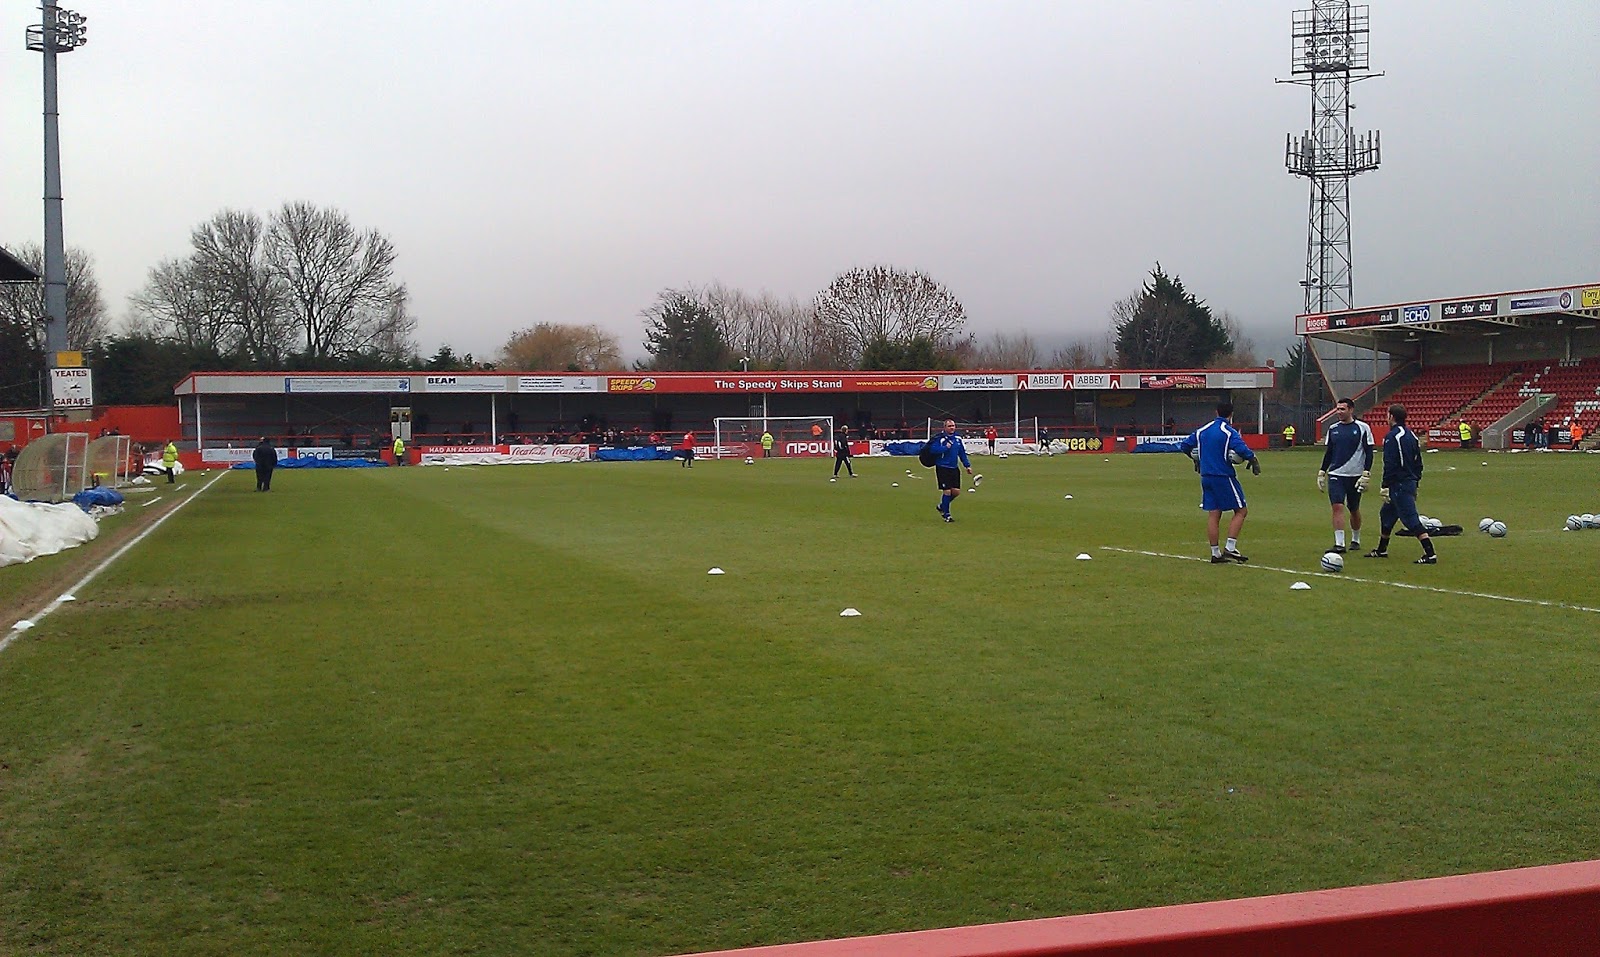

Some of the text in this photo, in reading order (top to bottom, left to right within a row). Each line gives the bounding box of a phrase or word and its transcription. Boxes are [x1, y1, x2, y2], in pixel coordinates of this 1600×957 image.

[1404, 309, 1430, 322] ECHO
[1033, 376, 1059, 384] ABBEY
[1078, 376, 1104, 384] ABBEY
[714, 380, 843, 390] The Speedy Skips Stand
